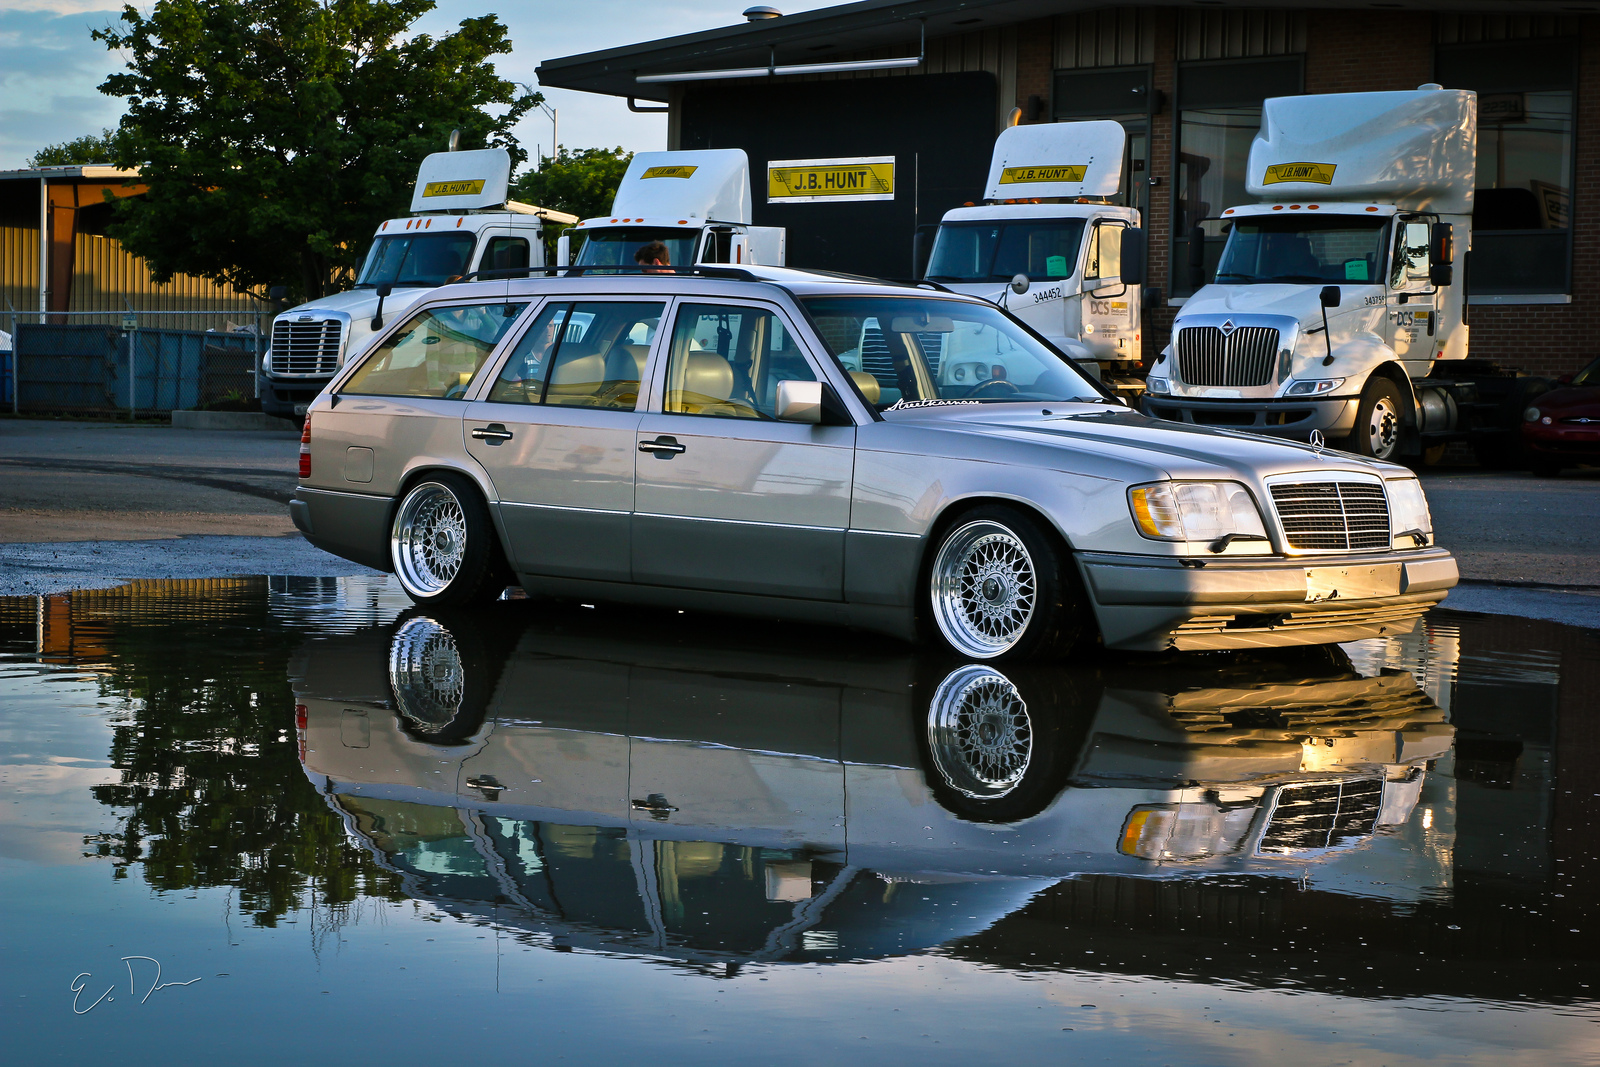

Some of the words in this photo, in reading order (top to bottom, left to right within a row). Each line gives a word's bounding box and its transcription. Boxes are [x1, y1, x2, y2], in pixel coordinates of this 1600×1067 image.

[1017, 170, 1036, 180] J.B.
[1038, 168, 1069, 179] HUNT
[1281, 167, 1294, 177] J.B.
[1293, 166, 1315, 177] HUNT
[794, 173, 822, 190] J.B.
[825, 171, 867, 189] HUNT
[435, 185, 448, 194] J.B.
[449, 184, 471, 192] HUNT
[1032, 287, 1062, 304] 344452
[1090, 301, 1110, 316] DCS
[1397, 311, 1413, 326] DCS
